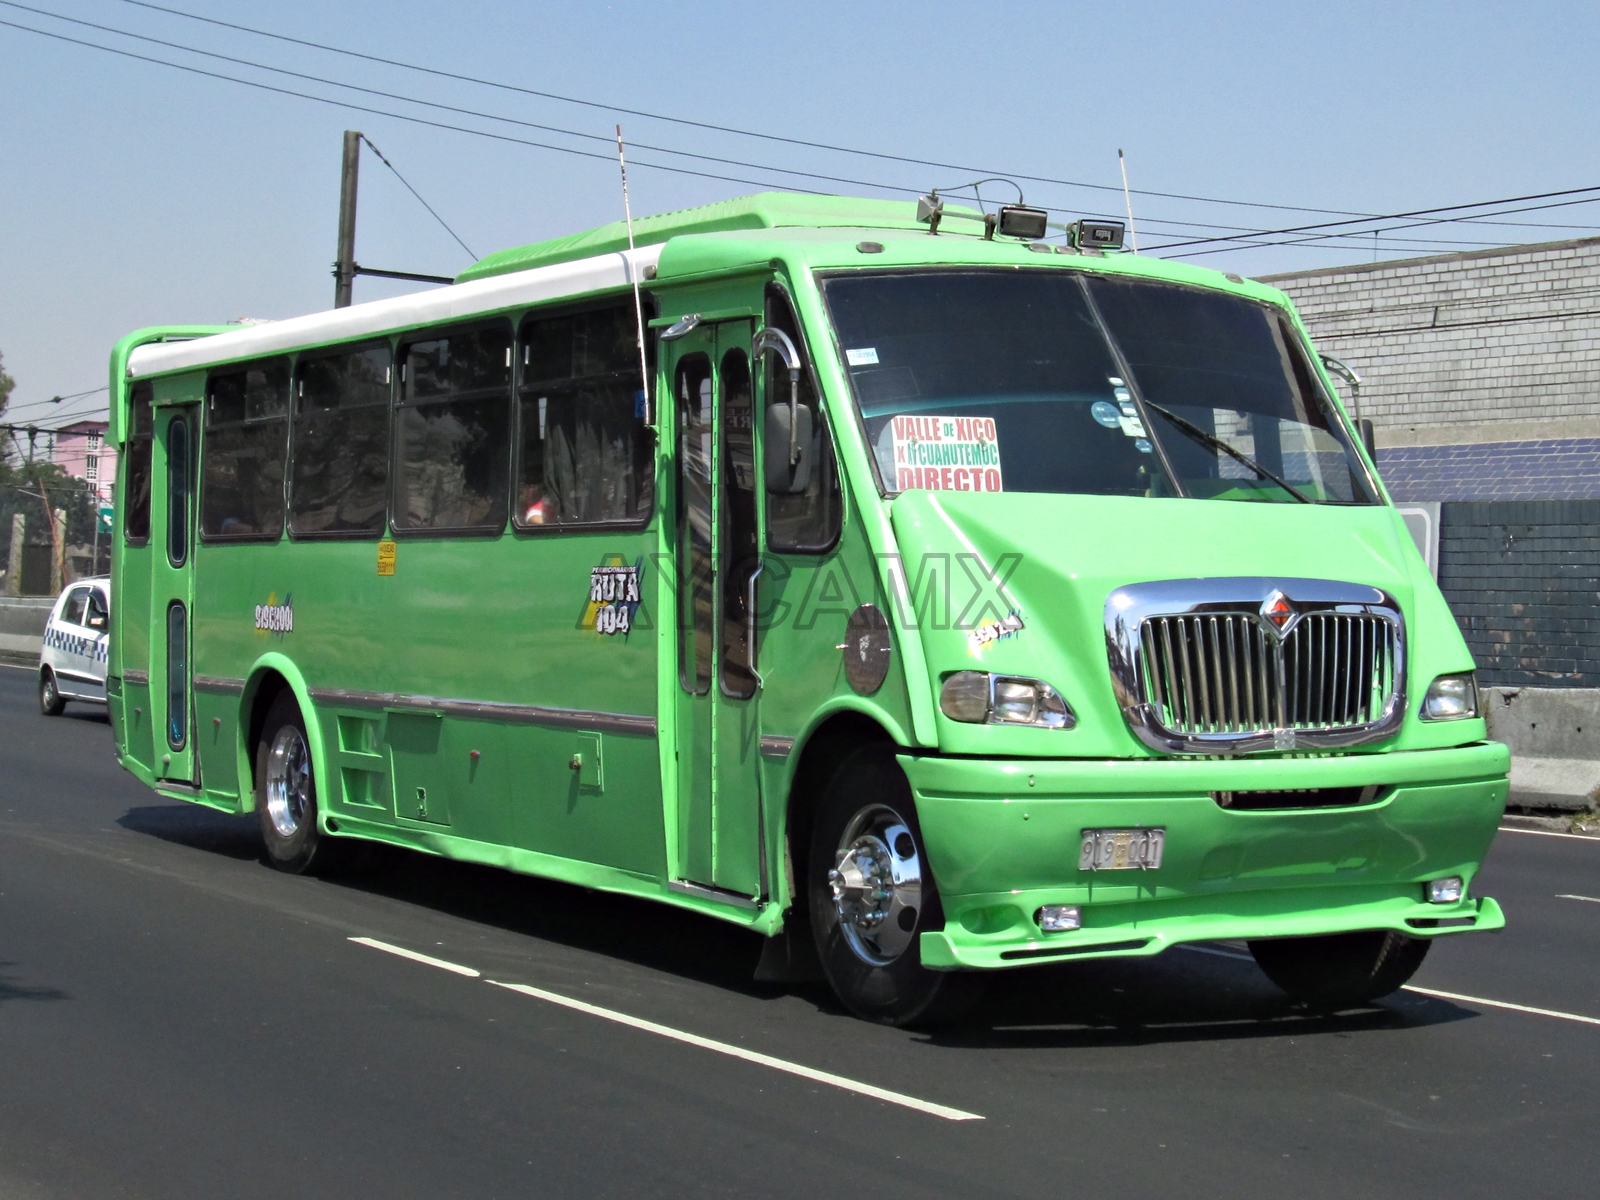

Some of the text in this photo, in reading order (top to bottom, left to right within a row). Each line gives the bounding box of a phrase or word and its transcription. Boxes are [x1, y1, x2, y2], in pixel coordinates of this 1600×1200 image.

[892, 417, 996, 441] VALLE DE XICO
[897, 445, 906, 463] X
[898, 467, 1000, 492] DIRECTO
[590, 573, 640, 603] RUTA
[595, 604, 630, 635] 104
